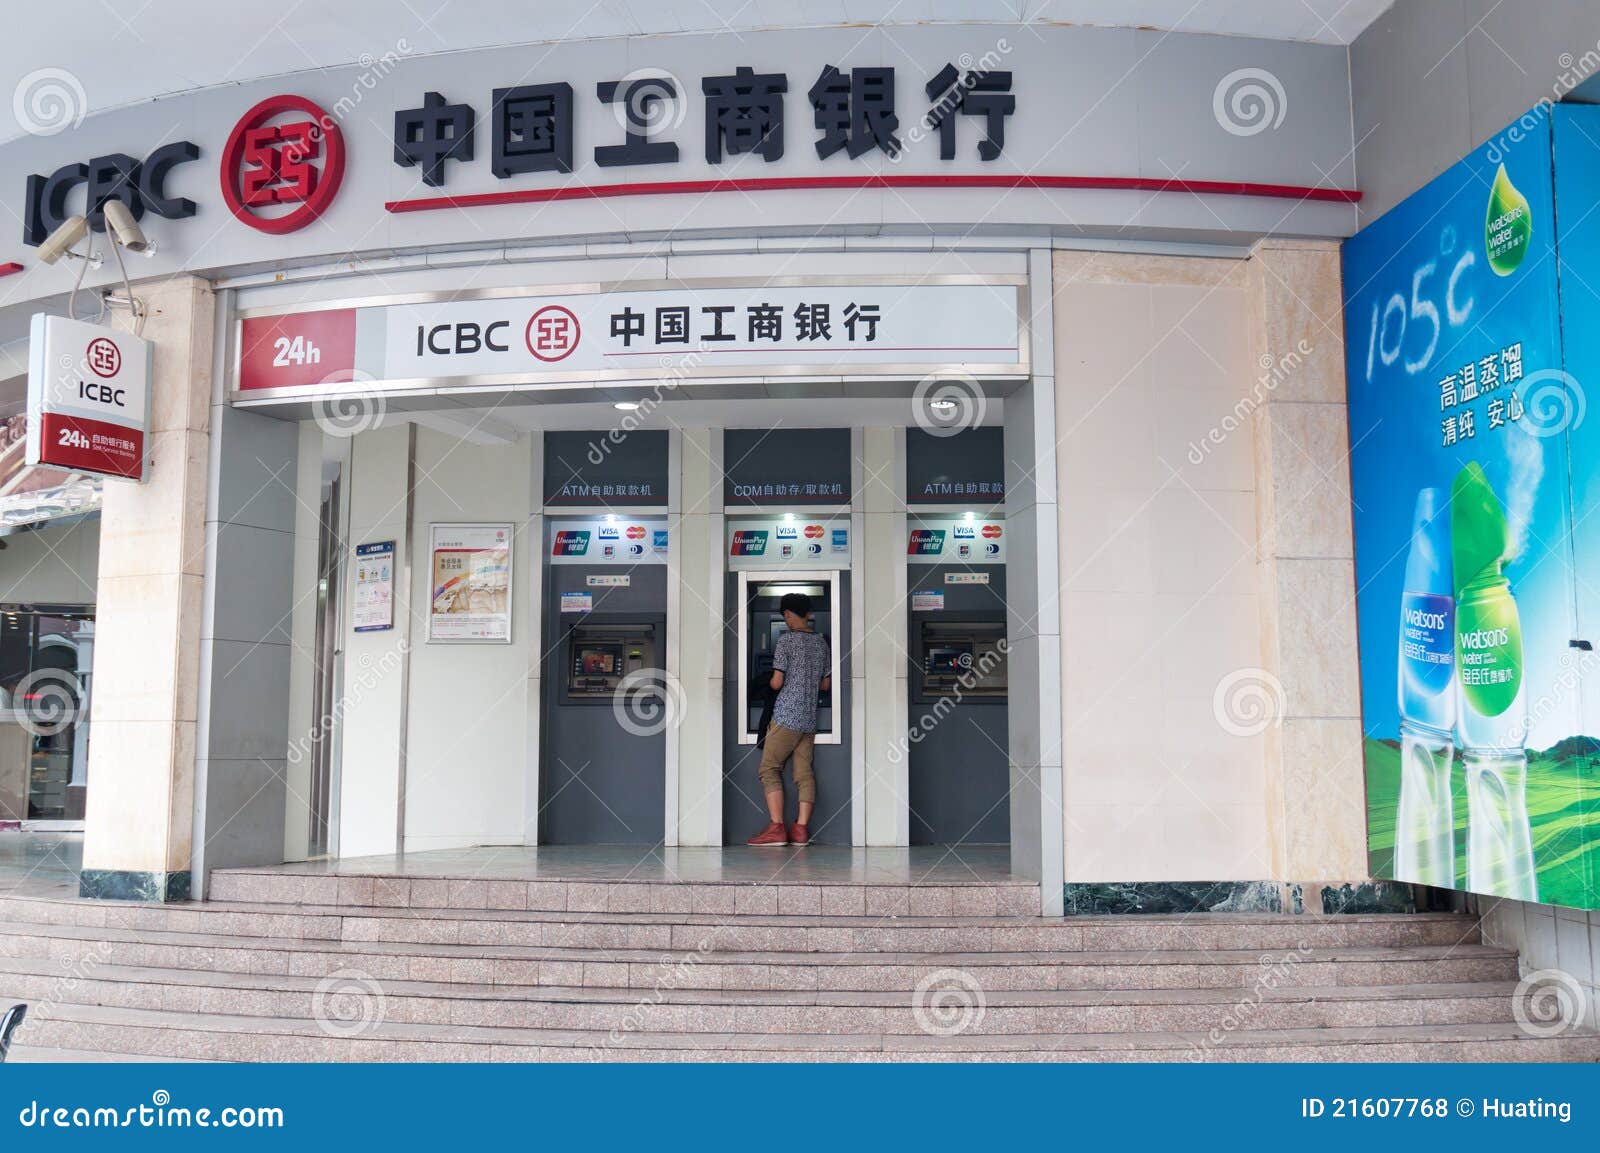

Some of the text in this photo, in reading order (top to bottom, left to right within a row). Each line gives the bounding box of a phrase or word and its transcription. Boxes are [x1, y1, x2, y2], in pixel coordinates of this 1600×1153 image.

[394, 62, 1016, 186] 中国工商银行
[23, 141, 200, 248] ICBC
[1487, 206, 1523, 234] watsons
[1488, 226, 1514, 249] water
[416, 320, 510, 357] ICBC
[608, 301, 882, 348] 中国工商银行
[272, 336, 320, 368] 24h
[1438, 342, 1524, 411] 高温蒸馏
[79, 381, 125, 407] ICBC
[1441, 391, 1525, 448] 清纯 安心
[58, 428, 90, 450] 24h
[779, 527, 797, 535] VISA
[956, 526, 974, 535] VISA
[1404, 607, 1445, 630] watsons
[1459, 627, 1509, 650] watsons
